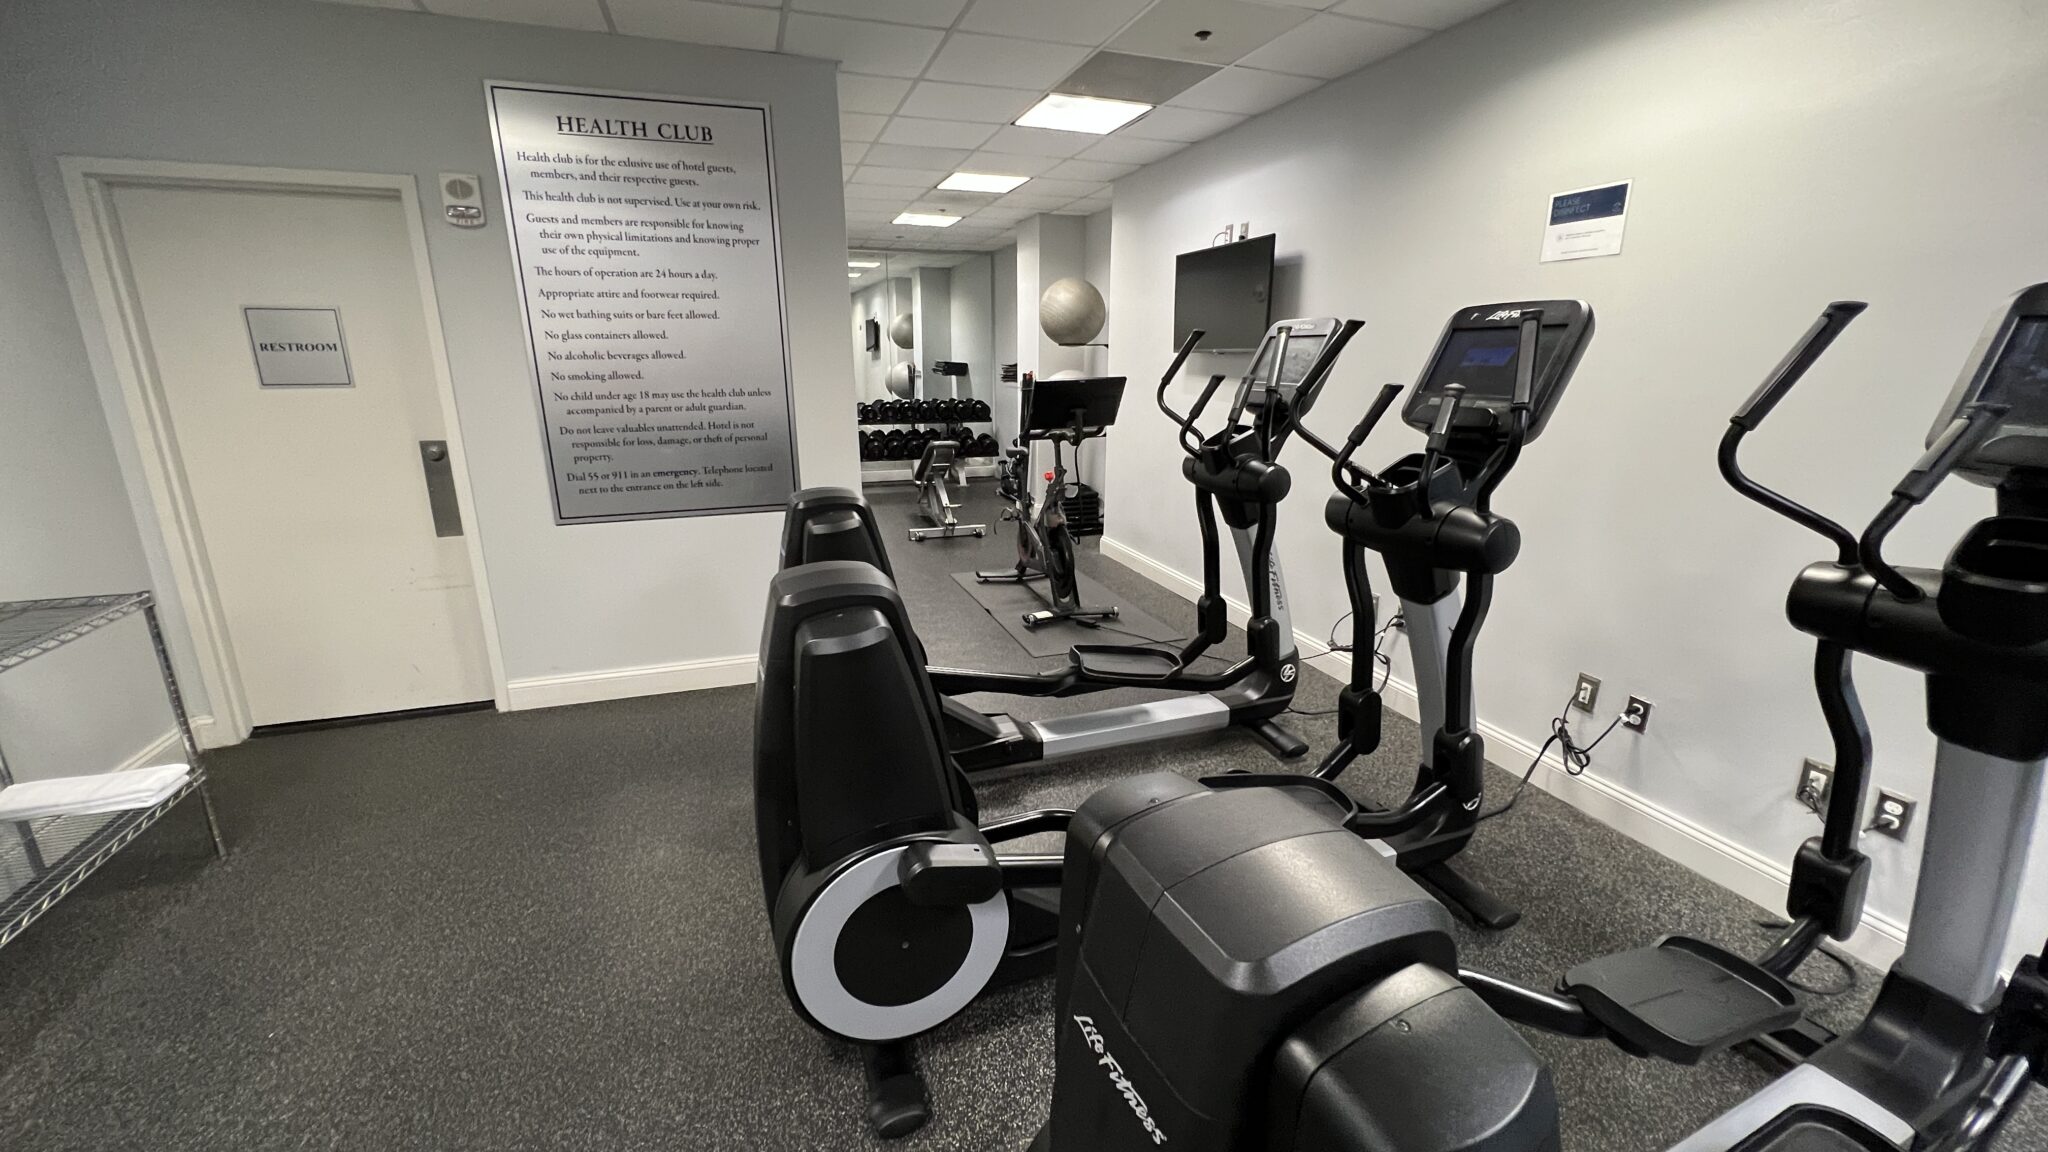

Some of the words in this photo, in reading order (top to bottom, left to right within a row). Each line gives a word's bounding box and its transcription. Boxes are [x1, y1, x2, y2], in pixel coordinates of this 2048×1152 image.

[556, 115, 648, 139] HEALTH
[657, 123, 713, 143] CLUB
[516, 151, 551, 164] Health
[552, 152, 574, 165] club
[575, 153, 583, 166] is
[584, 154, 599, 167] for
[600, 155, 616, 168] the
[617, 157, 653, 170] exlusive
[655, 161, 670, 171] use
[671, 159, 682, 172] of
[681, 160, 706, 173] hotel
[530, 167, 578, 183] members,
[578, 169, 597, 182] and
[598, 170, 622, 183] their
[622, 172, 668, 189] respective
[522, 189, 544, 202] This
[544, 191, 575, 203] health
[575, 191, 596, 204] club
[597, 192, 605, 205] is
[606, 194, 623, 205] not
[624, 194, 674, 211] supervised.
[674, 196, 691, 208] Use
[692, 198, 701, 209] at
[702, 200, 722, 213] your
[723, 201, 741, 211] own
[742, 199, 760, 211] risk.
[525, 212, 559, 225] Guests
[560, 213, 579, 226] and
[580, 215, 623, 227] members
[624, 218, 639, 228] are
[640, 217, 691, 233] responsible
[691, 218, 705, 230] for
[706, 220, 744, 235] knowing
[539, 227, 562, 240] their
[563, 231, 584, 241] own
[585, 230, 624, 245] physical
[624, 231, 673, 243] limitations
[674, 232, 691, 244] and
[692, 234, 731, 248] knowing
[732, 238, 760, 249] proper
[541, 246, 557, 255] use
[558, 243, 571, 256] of
[569, 244, 586, 256] the
[587, 245, 640, 261] equipment.
[534, 264, 553, 276] The
[554, 265, 582, 277] hours
[582, 265, 595, 277] of
[593, 267, 639, 281] operation
[640, 270, 654, 278] are
[655, 267, 666, 279] 24
[668, 267, 693, 279] hours
[694, 271, 700, 279] a
[700, 268, 718, 283] day.
[537, 287, 595, 302] Appropriate
[596, 288, 621, 299] attire
[621, 287, 639, 299] and
[640, 289, 680, 299] footwear
[681, 289, 720, 303] required.
[540, 308, 557, 319] No
[557, 309, 574, 319] wet
[576, 309, 612, 323] bathing
[612, 308, 633, 320] suits
[634, 311, 645, 320] or
[646, 308, 666, 320] bare
[667, 309, 683, 320] feet
[685, 310, 720, 320] allowed.
[544, 329, 560, 340] No
[560, 329, 583, 344] glass
[584, 330, 631, 340] containers
[632, 330, 668, 340] allowed.
[259, 342, 338, 352] RESTROOM
[547, 350, 563, 361] No
[564, 350, 606, 361] alcoholic
[606, 350, 650, 364] beverages
[650, 350, 686, 360] allowed.
[550, 370, 566, 381] No
[567, 371, 607, 384] smoking
[606, 370, 644, 380] allowed.
[553, 390, 569, 402] No
[570, 390, 593, 401] child
[594, 389, 621, 401] under
[622, 392, 638, 403] age
[639, 389, 650, 400] 18
[651, 391, 670, 402] may
[671, 391, 685, 399] use
[686, 388, 700, 399] the
[701, 388, 727, 398] health
[728, 387, 746, 398] club
[747, 387, 771, 397] unless
[566, 404, 625, 419] accompanied
[625, 403, 637, 417] by
[638, 406, 644, 414] a
[645, 405, 673, 417] parent
[674, 405, 684, 413] or
[684, 402, 707, 413] adult
[707, 402, 746, 415] guardian.
[559, 424, 575, 435] Do
[576, 425, 592, 435] not
[592, 423, 615, 434] leave
[616, 423, 655, 434] valuables
[656, 421, 706, 432] unattended.
[707, 419, 731, 430] Hotel
[732, 419, 739, 430] is
[740, 420, 755, 429] not
[571, 437, 621, 452] responsible
[622, 436, 636, 447] for
[636, 435, 656, 448] loss,
[692, 436, 703, 444] or
[702, 433, 723, 444] theft
[724, 432, 734, 443] of
[734, 432, 768, 445] personal
[566, 471, 587, 482] Dial
[587, 470, 599, 481] 55
[600, 472, 611, 480] or
[611, 469, 628, 480] 911
[630, 468, 639, 479] in
[640, 470, 651, 478] an
[701, 464, 744, 478] Telephone
[744, 463, 774, 473] located
[578, 485, 598, 495] next
[599, 484, 609, 494] to
[609, 482, 624, 493] the
[625, 482, 662, 492] entrance
[663, 482, 675, 490] on
[675, 479, 689, 489] the
[690, 478, 704, 489] left
[705, 477, 723, 488] side.
